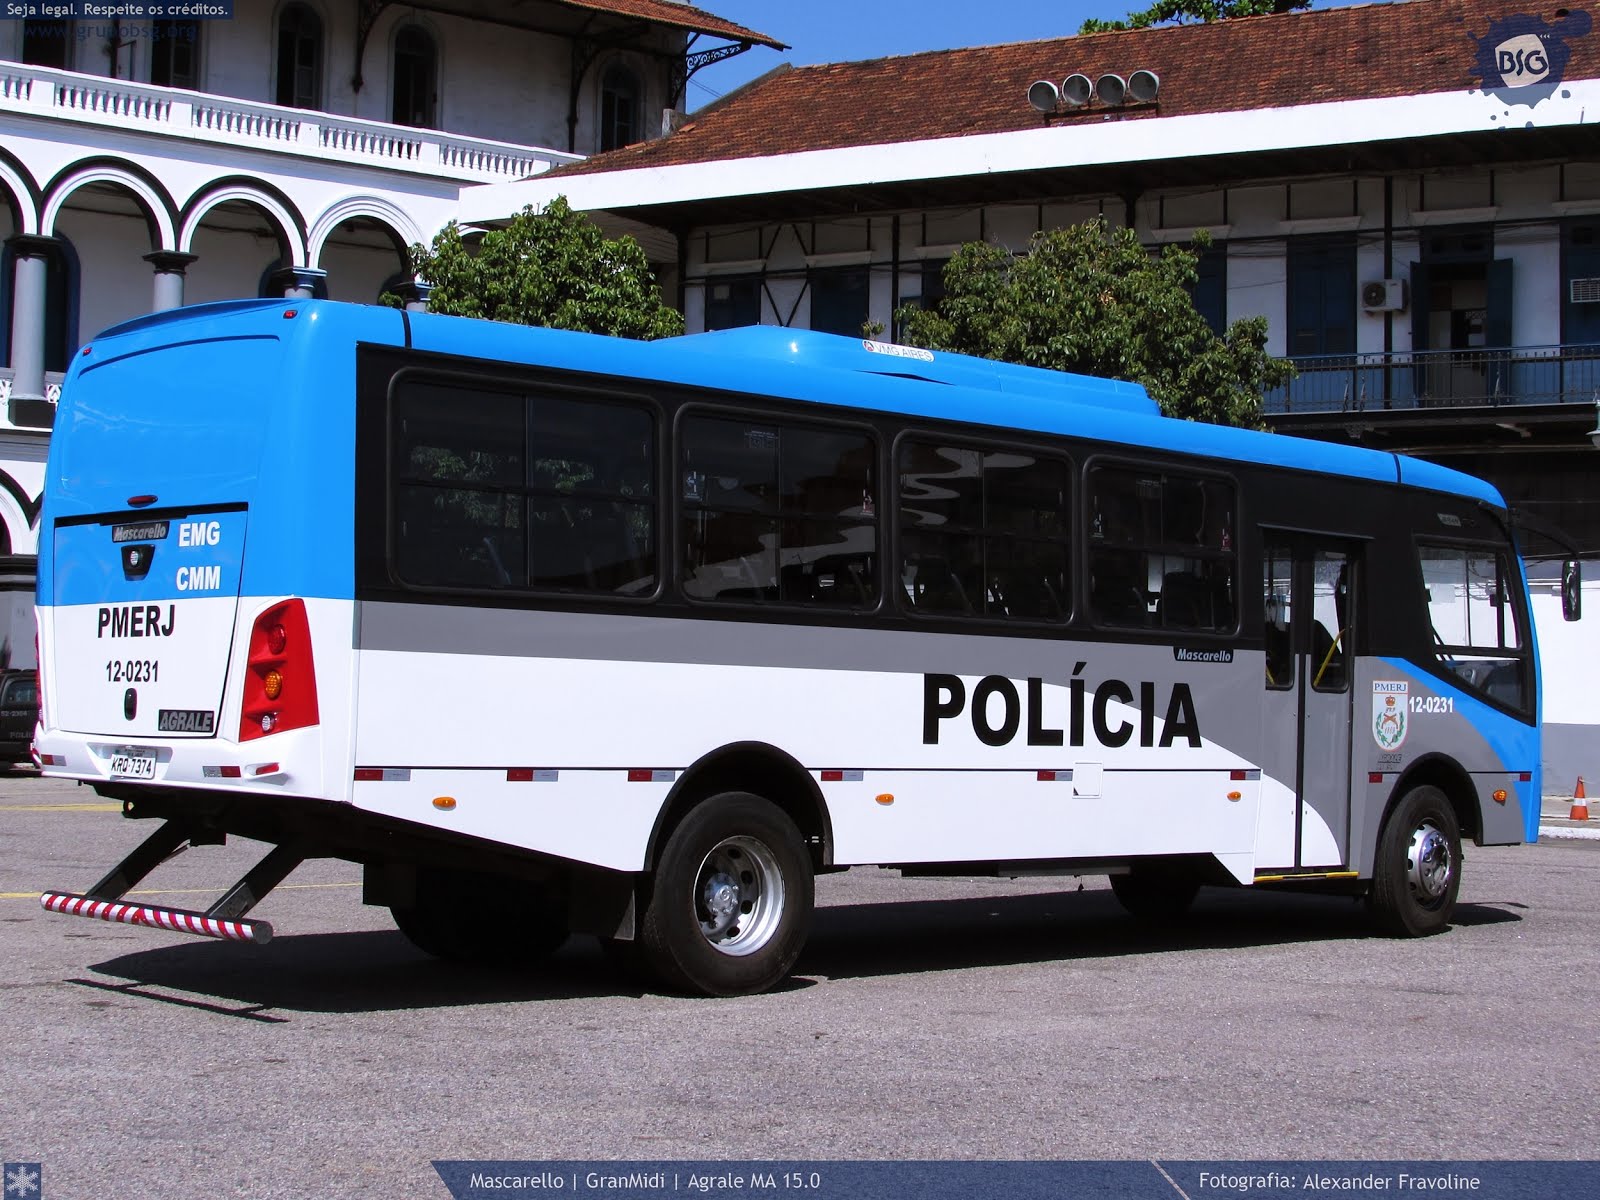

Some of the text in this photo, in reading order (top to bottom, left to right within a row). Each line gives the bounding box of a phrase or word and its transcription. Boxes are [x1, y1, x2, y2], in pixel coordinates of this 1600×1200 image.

[113, 523, 166, 541] Mascarello
[178, 521, 221, 547] EMG
[176, 566, 221, 591] CMM
[97, 604, 176, 638] PMERJ
[1177, 648, 1231, 661] Mascarello
[106, 660, 159, 682] 12-0231
[1374, 683, 1407, 691] PMERJ
[922, 661, 1203, 748] POLÍCIA
[1409, 696, 1454, 713] 12-0231
[160, 711, 213, 731] AGRALE
